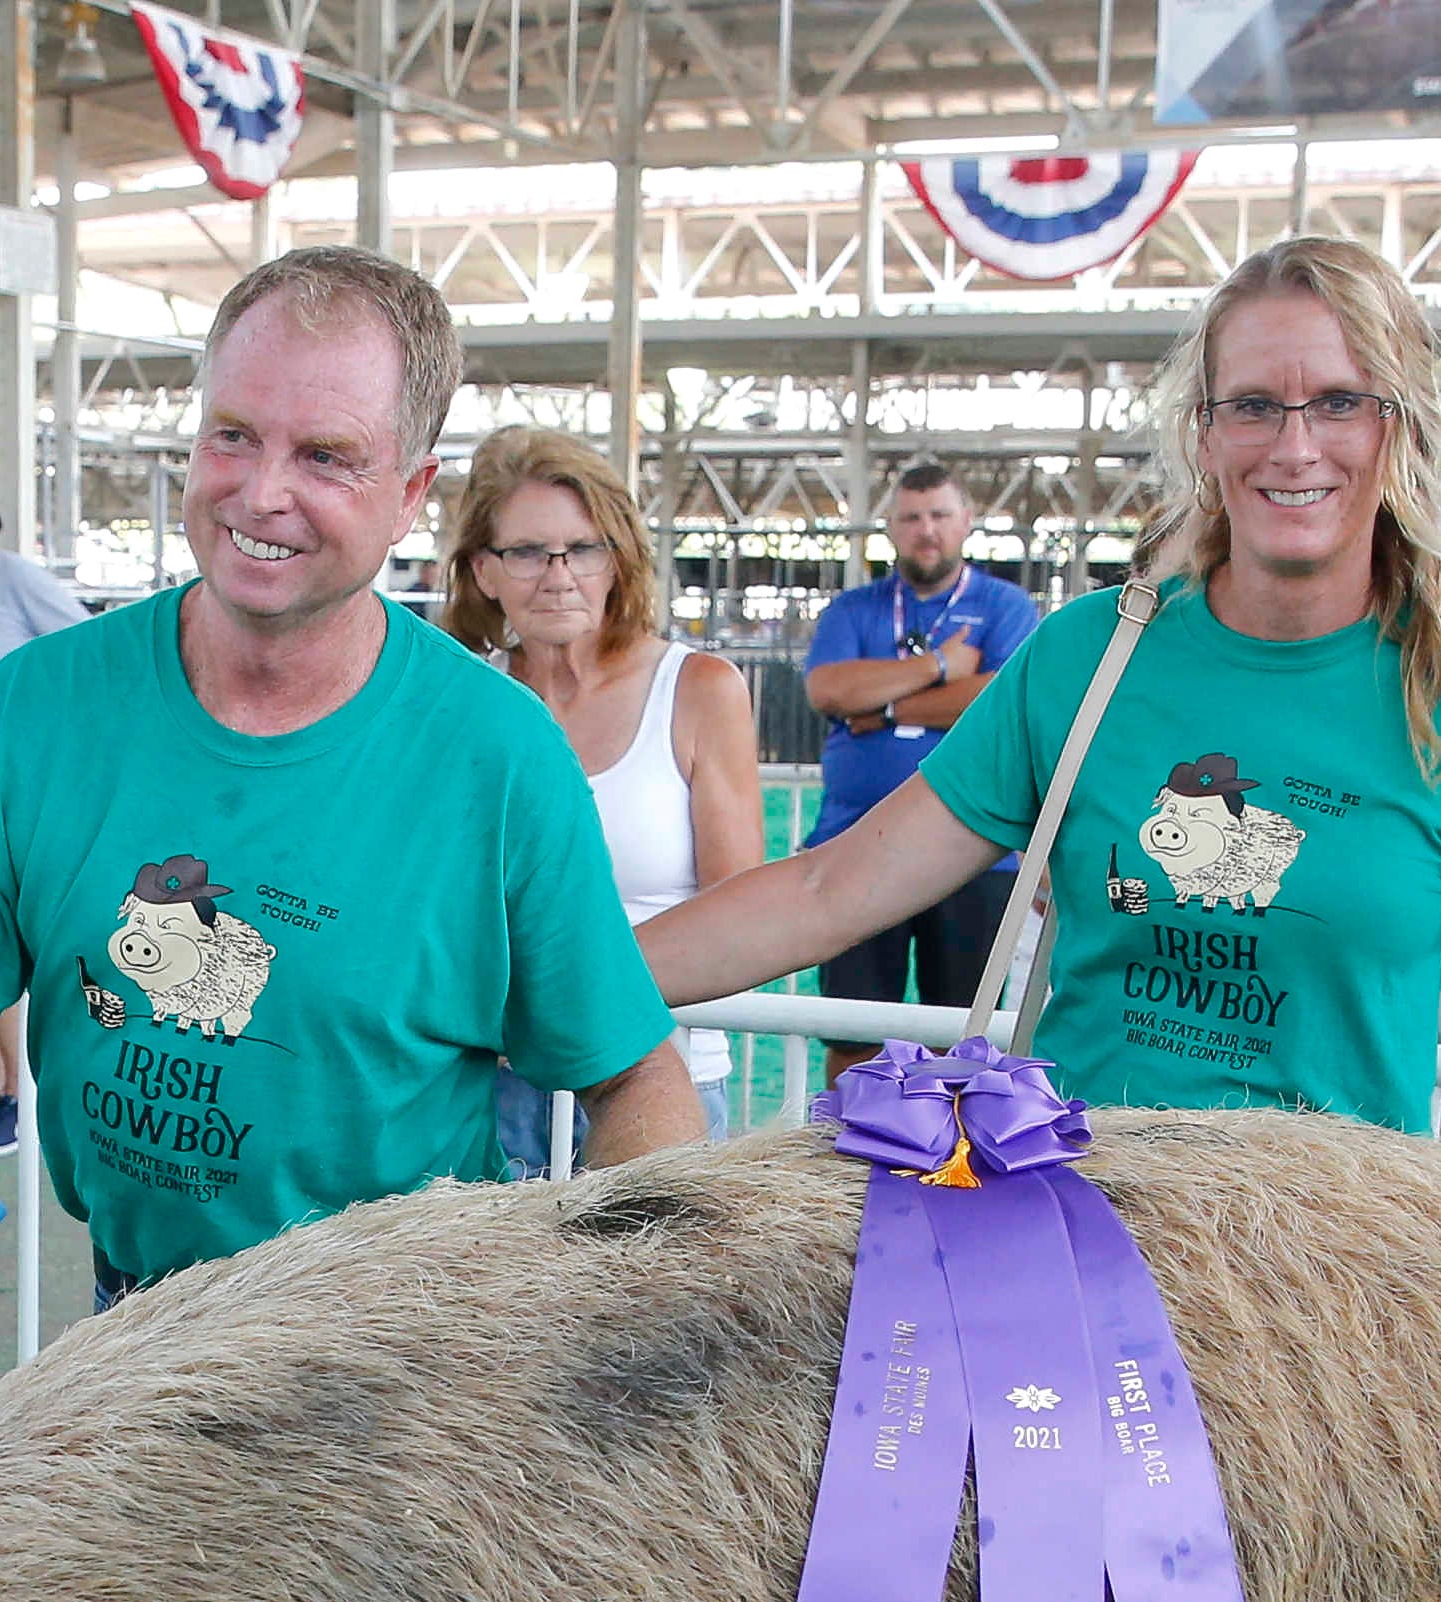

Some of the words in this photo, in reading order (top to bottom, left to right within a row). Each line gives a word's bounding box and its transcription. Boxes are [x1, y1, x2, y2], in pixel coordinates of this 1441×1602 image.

[1283, 776, 1332, 799] GOTTA
[1341, 793, 1361, 807] BE
[1288, 793, 1348, 819] TOUGH!
[256, 883, 309, 911] GOTTA
[317, 904, 340, 921] BE
[260, 902, 322, 932] TOUGH!
[1151, 924, 1259, 972] IRISH
[1123, 962, 1288, 1028] COWBOY
[1122, 1008, 1156, 1029] IOWA
[1159, 1018, 1204, 1044] STATE
[1208, 1031, 1242, 1054] FAIR
[1245, 1037, 1272, 1055] 2021
[1126, 1027, 1146, 1047] BIG
[1147, 1034, 1186, 1058] BOAR
[1188, 1044, 1257, 1071] CONTEST
[113, 1040, 223, 1105] IRISH
[82, 1081, 253, 1160] COWBOY
[89, 1129, 120, 1156] IOWA
[123, 1148, 165, 1171] STATE
[167, 1161, 200, 1183] FAIR
[206, 1167, 239, 1185] 2021
[119, 1161, 152, 1188] BOAR
[156, 1174, 223, 1203] CONTEST
[894, 1319, 918, 1360] FAIR
[885, 1362, 912, 1415] STATE
[1106, 1395, 1123, 1418] BIG
[907, 1406, 923, 1435] DES
[1013, 1425, 1062, 1449] 2021
[1114, 1359, 1151, 1415] FIRST
[1134, 1423, 1171, 1488] PLACE
[1114, 1421, 1134, 1456] BOAR
[874, 1418, 902, 1471] IOWA
